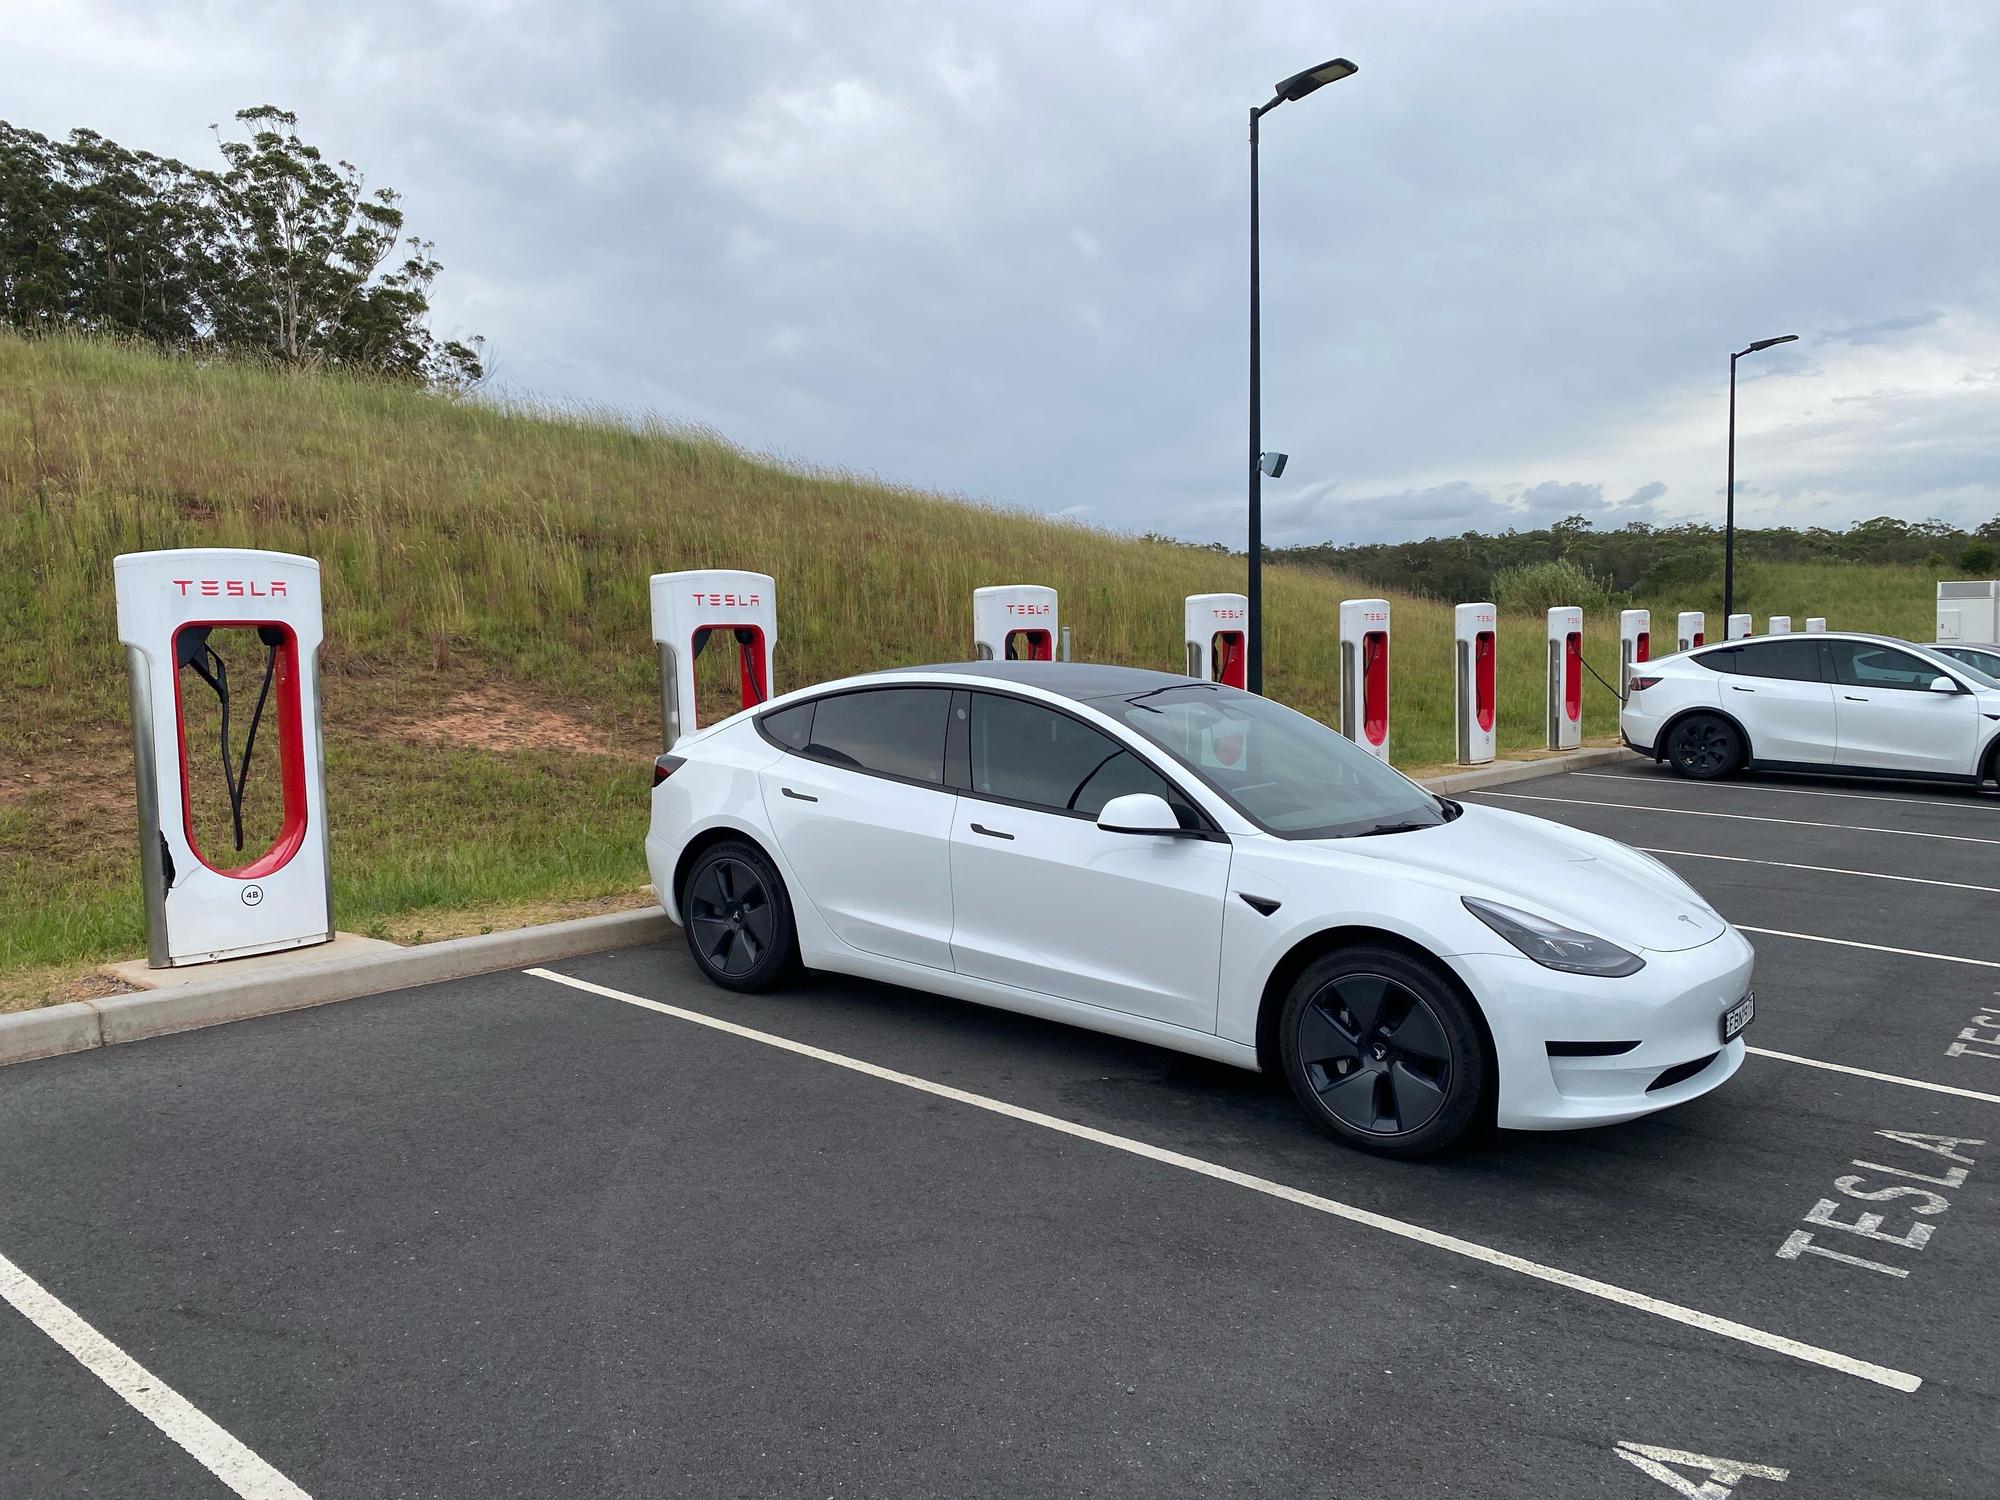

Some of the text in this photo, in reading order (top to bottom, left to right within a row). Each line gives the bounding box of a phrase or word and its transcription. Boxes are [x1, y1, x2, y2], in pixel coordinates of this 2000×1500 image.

[173, 580, 287, 597] TESLA
[692, 594, 760, 607] TESLA
[1006, 605, 1051, 615] TESLA
[1213, 610, 1244, 619] TESLA
[246, 891, 259, 899] 4B
[1775, 1129, 1987, 1279] TESLA
